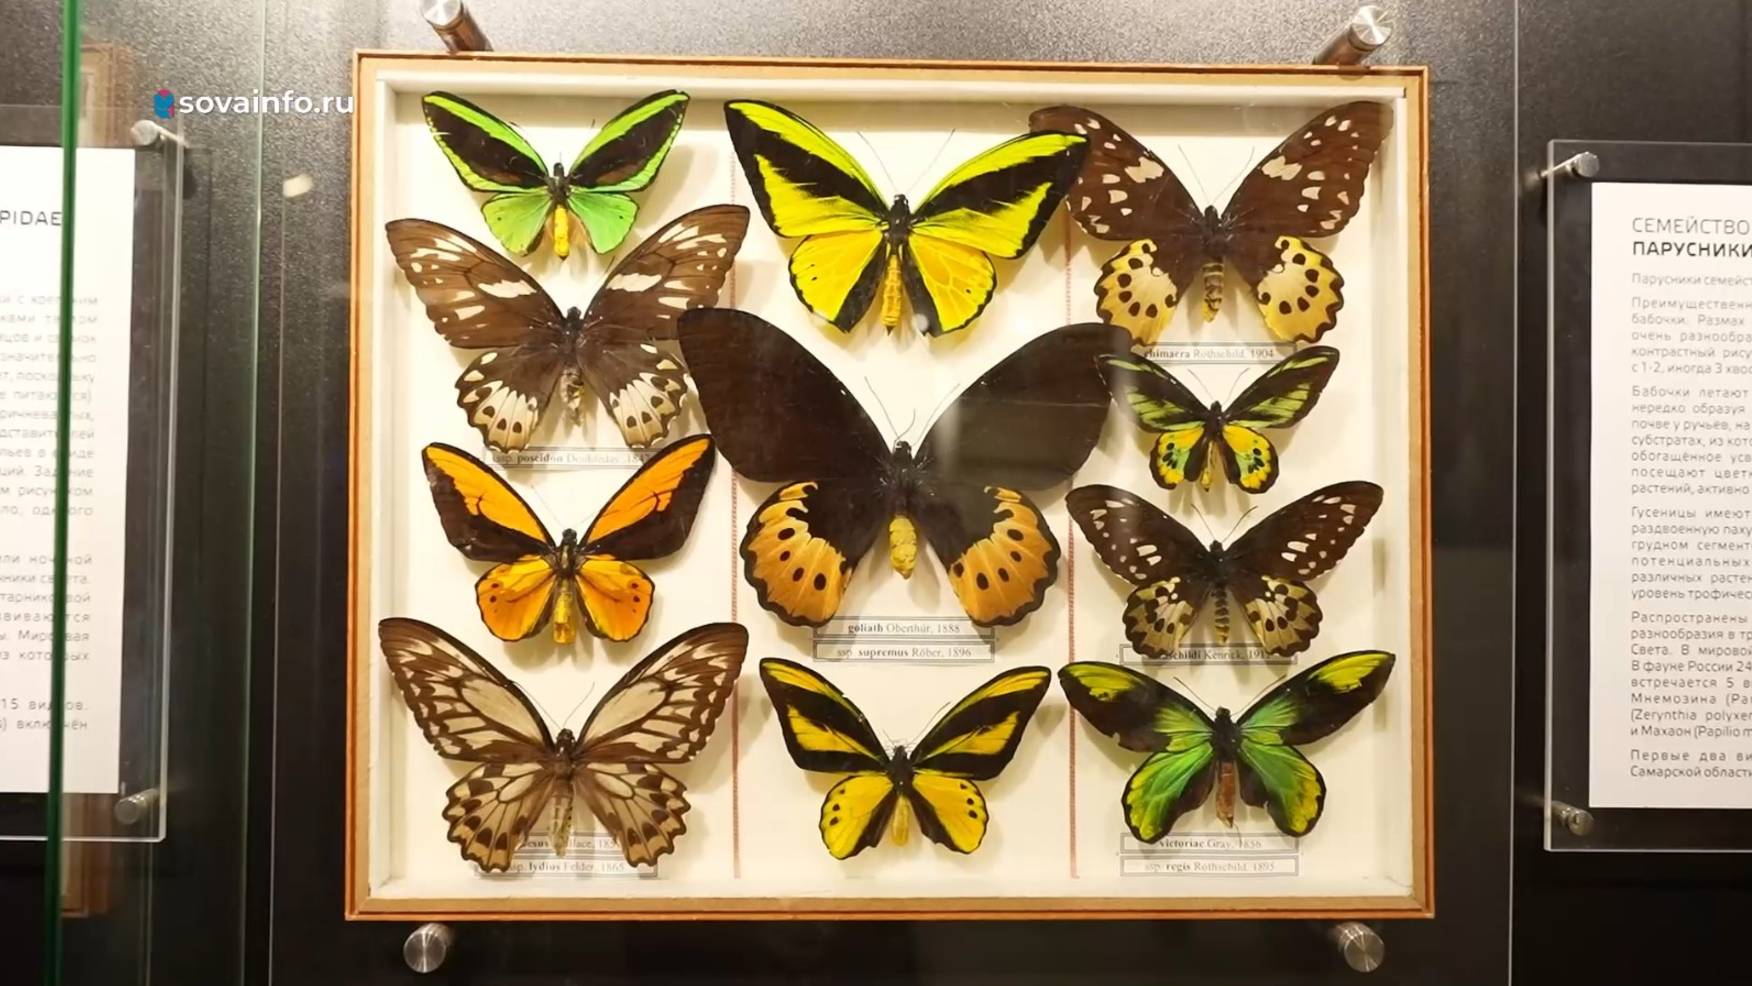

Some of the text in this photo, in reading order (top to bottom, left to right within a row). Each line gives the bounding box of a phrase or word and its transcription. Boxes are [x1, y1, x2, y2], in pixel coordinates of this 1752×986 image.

[1632, 216, 1750, 235] СЕМЕЙСТВО
[1633, 241, 1752, 257] ПАРУСНИКИ
[1697, 314, 1744, 326] Размах
[1632, 385, 1690, 397] Бабочки
[1692, 402, 1745, 416] образуя
[1632, 506, 1751, 519] Гусеницы имеют
[1632, 541, 1752, 551] грудном сегмент
[1632, 557, 1751, 568] потенциальных
[1632, 573, 1702, 583] различных
[1632, 589, 1685, 600] уровень
[1632, 611, 1748, 625] Распространены
[848, 622, 883, 634] goliath
[937, 623, 960, 633] 1888
[1631, 628, 1724, 640] разнообразия
[858, 649, 909, 660] supremus
[948, 647, 972, 658] 1896
[1643, 661, 1685, 673] фауне
[1688, 660, 1733, 672] России
[1631, 678, 1718, 689] встречается
[1631, 692, 1717, 704] Мнемозина
[1631, 708, 1697, 723] (Zerynthia
[1641, 725, 1691, 737] Махаон
[1694, 725, 1740, 739] (Papilio
[1630, 749, 1690, 762] Первые
[1699, 752, 1726, 762] два
[1630, 765, 1701, 779] Самарской
